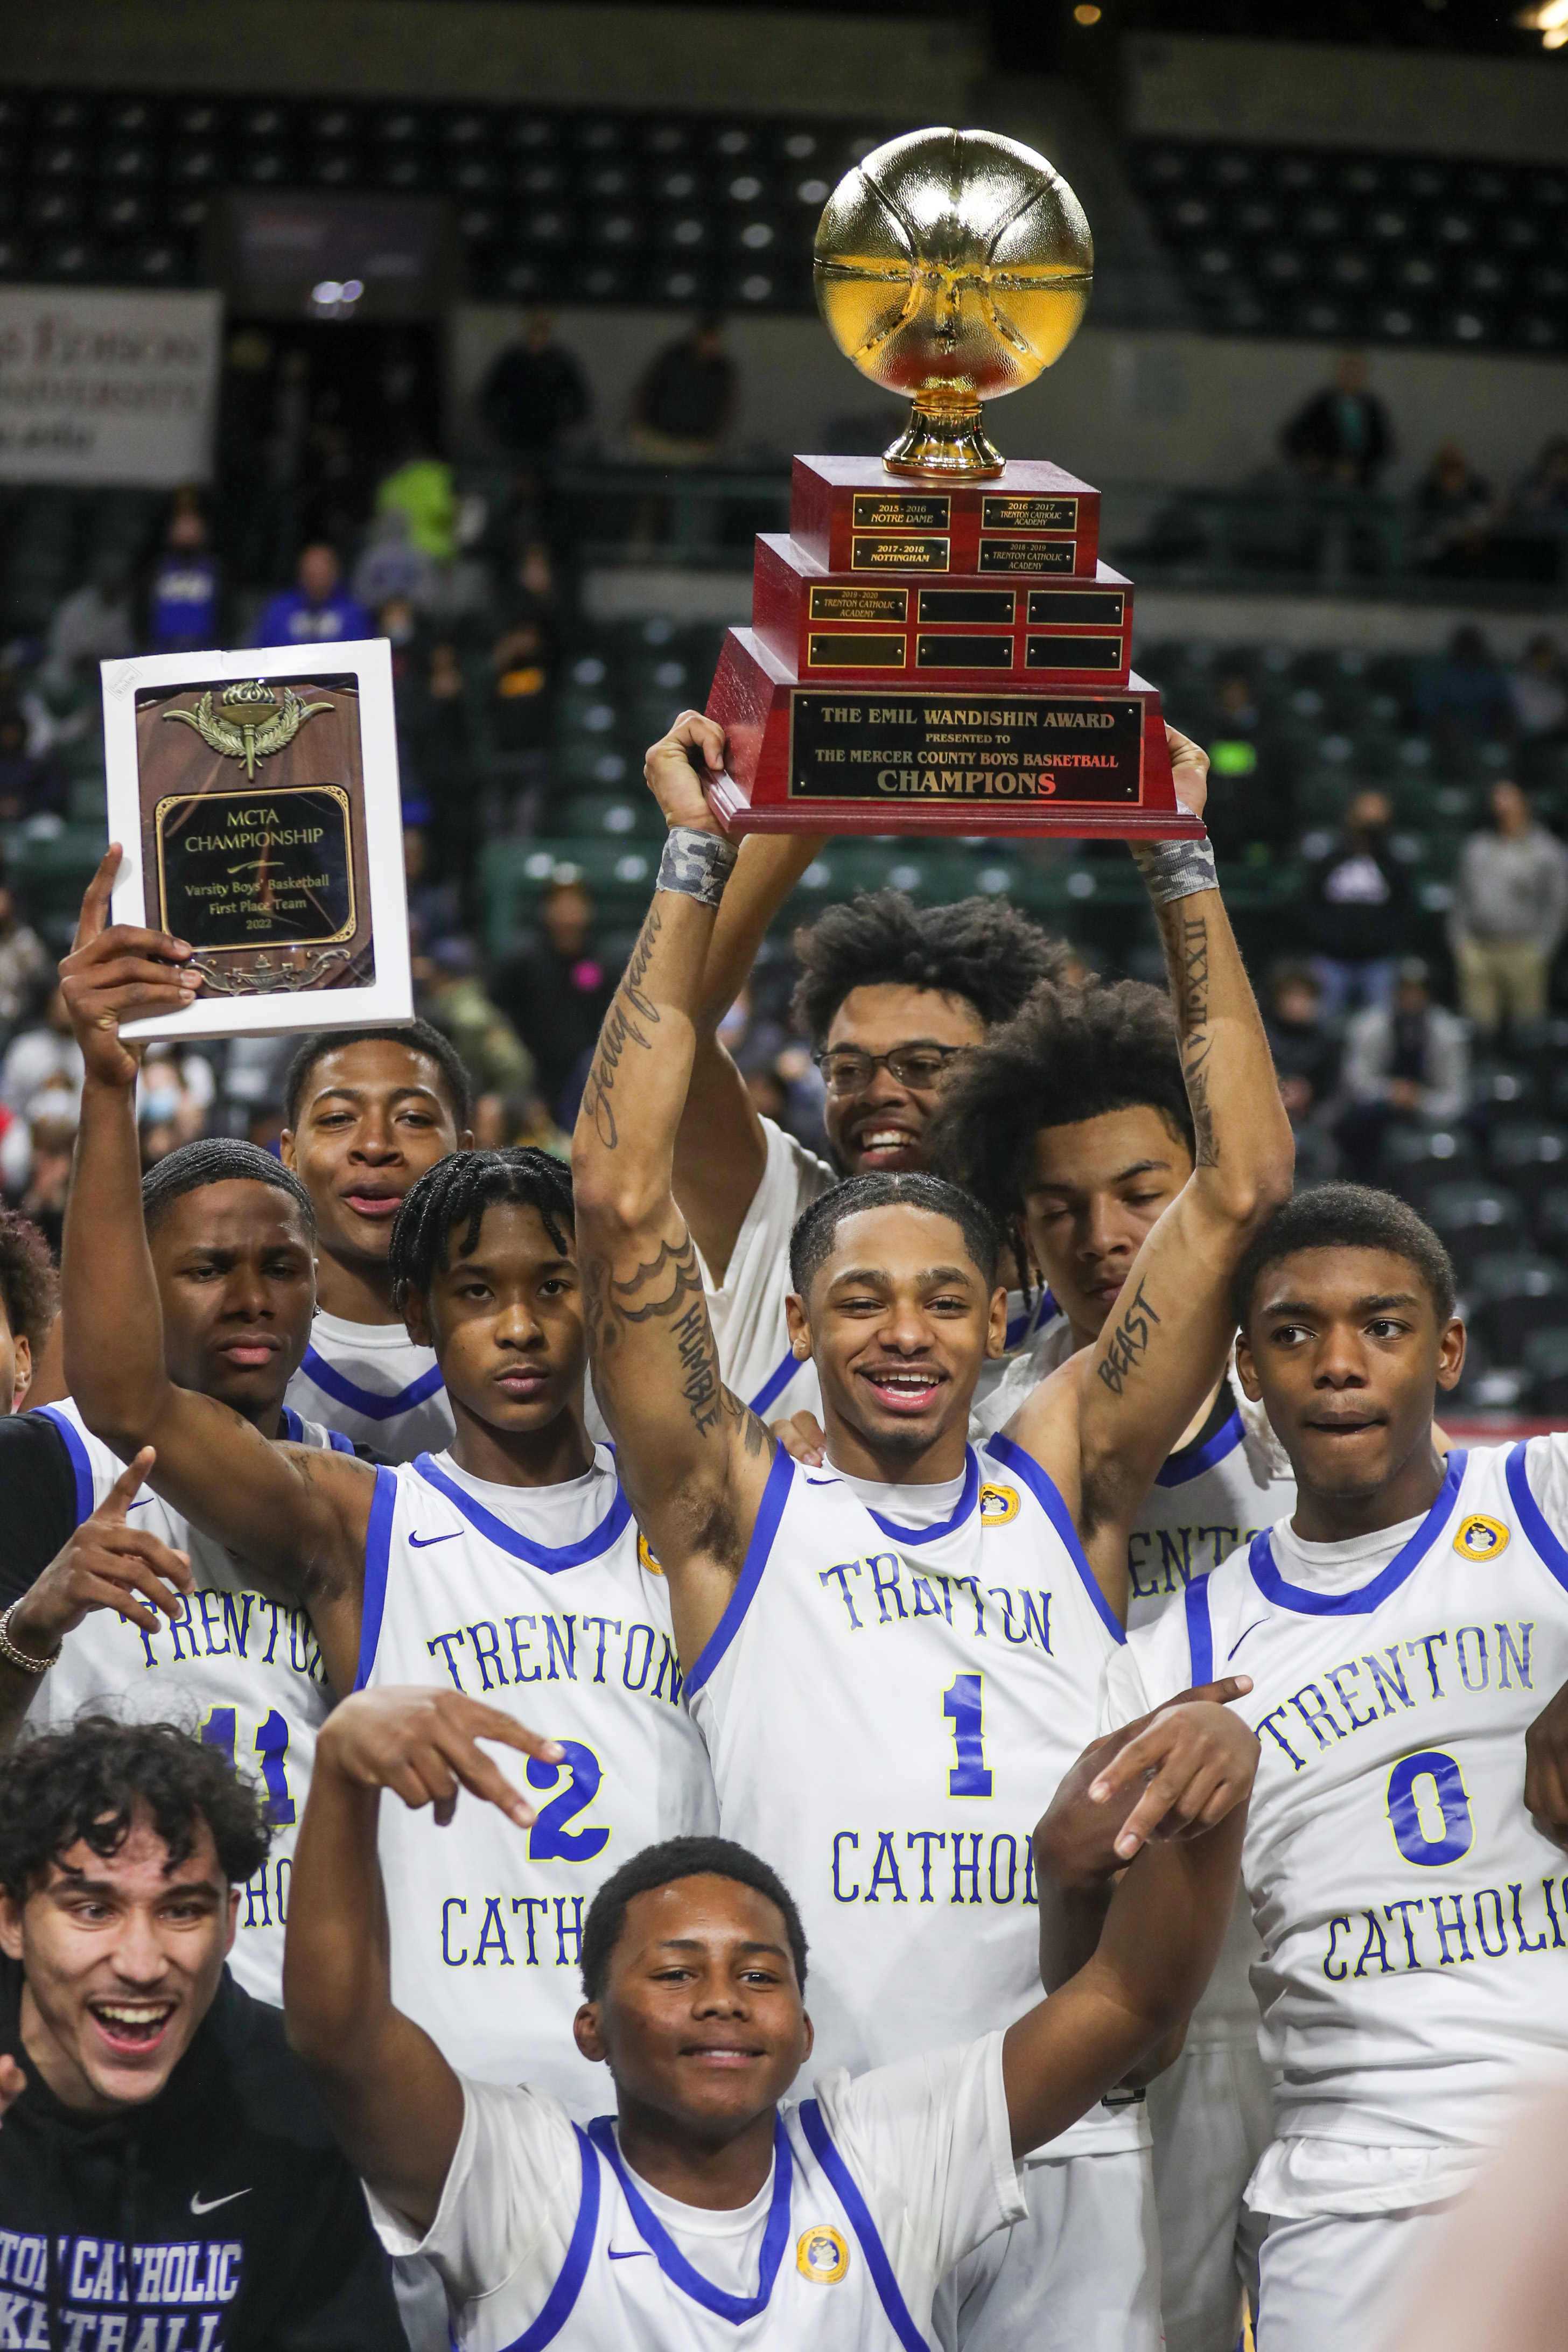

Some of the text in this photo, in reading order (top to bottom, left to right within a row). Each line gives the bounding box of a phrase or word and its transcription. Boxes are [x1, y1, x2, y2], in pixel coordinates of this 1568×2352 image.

[870, 514, 934, 523] NOTRE DAME
[1014, 518, 1048, 526] ACADEMY
[870, 554, 930, 562] NOTTINGHAM
[992, 551, 1063, 561] TRENTON CATHOLIC
[1008, 562, 1043, 570] ACADEMY
[824, 598, 895, 609] TRENTON CATHOLIC
[839, 609, 876, 618] ACADEMY
[821, 708, 1115, 729] THE EMIL WANDISHIN AWARD
[926, 733, 1011, 744] PRESENTED TO
[815, 749, 1118, 768] THE MERCER COUNTY BOYS BASKETBALL
[877, 769, 1056, 795] CHAMPIONS
[227, 808, 279, 827] MCTA
[185, 827, 324, 852] CHAMPIONSHIP
[185, 881, 229, 898] Varsity
[268, 874, 330, 890] Basketball
[209, 898, 307, 915] First Place Team
[246, 919, 272, 930] 2022
[1097, 1272, 1161, 1396] BEAST
[669, 1301, 718, 1439] HUMBLE
[1128, 1525, 1263, 1600] ENT
[426, 1613, 685, 1708] TRENTON
[1254, 1620, 1537, 1774] TRENTON
[940, 1671, 996, 1800] 1
[524, 1737, 612, 1864] 2
[1385, 1748, 1476, 1868] 0
[1322, 1876, 1568, 1982] CATHOLI
[71, 2239, 241, 2302] CATHOLIC
